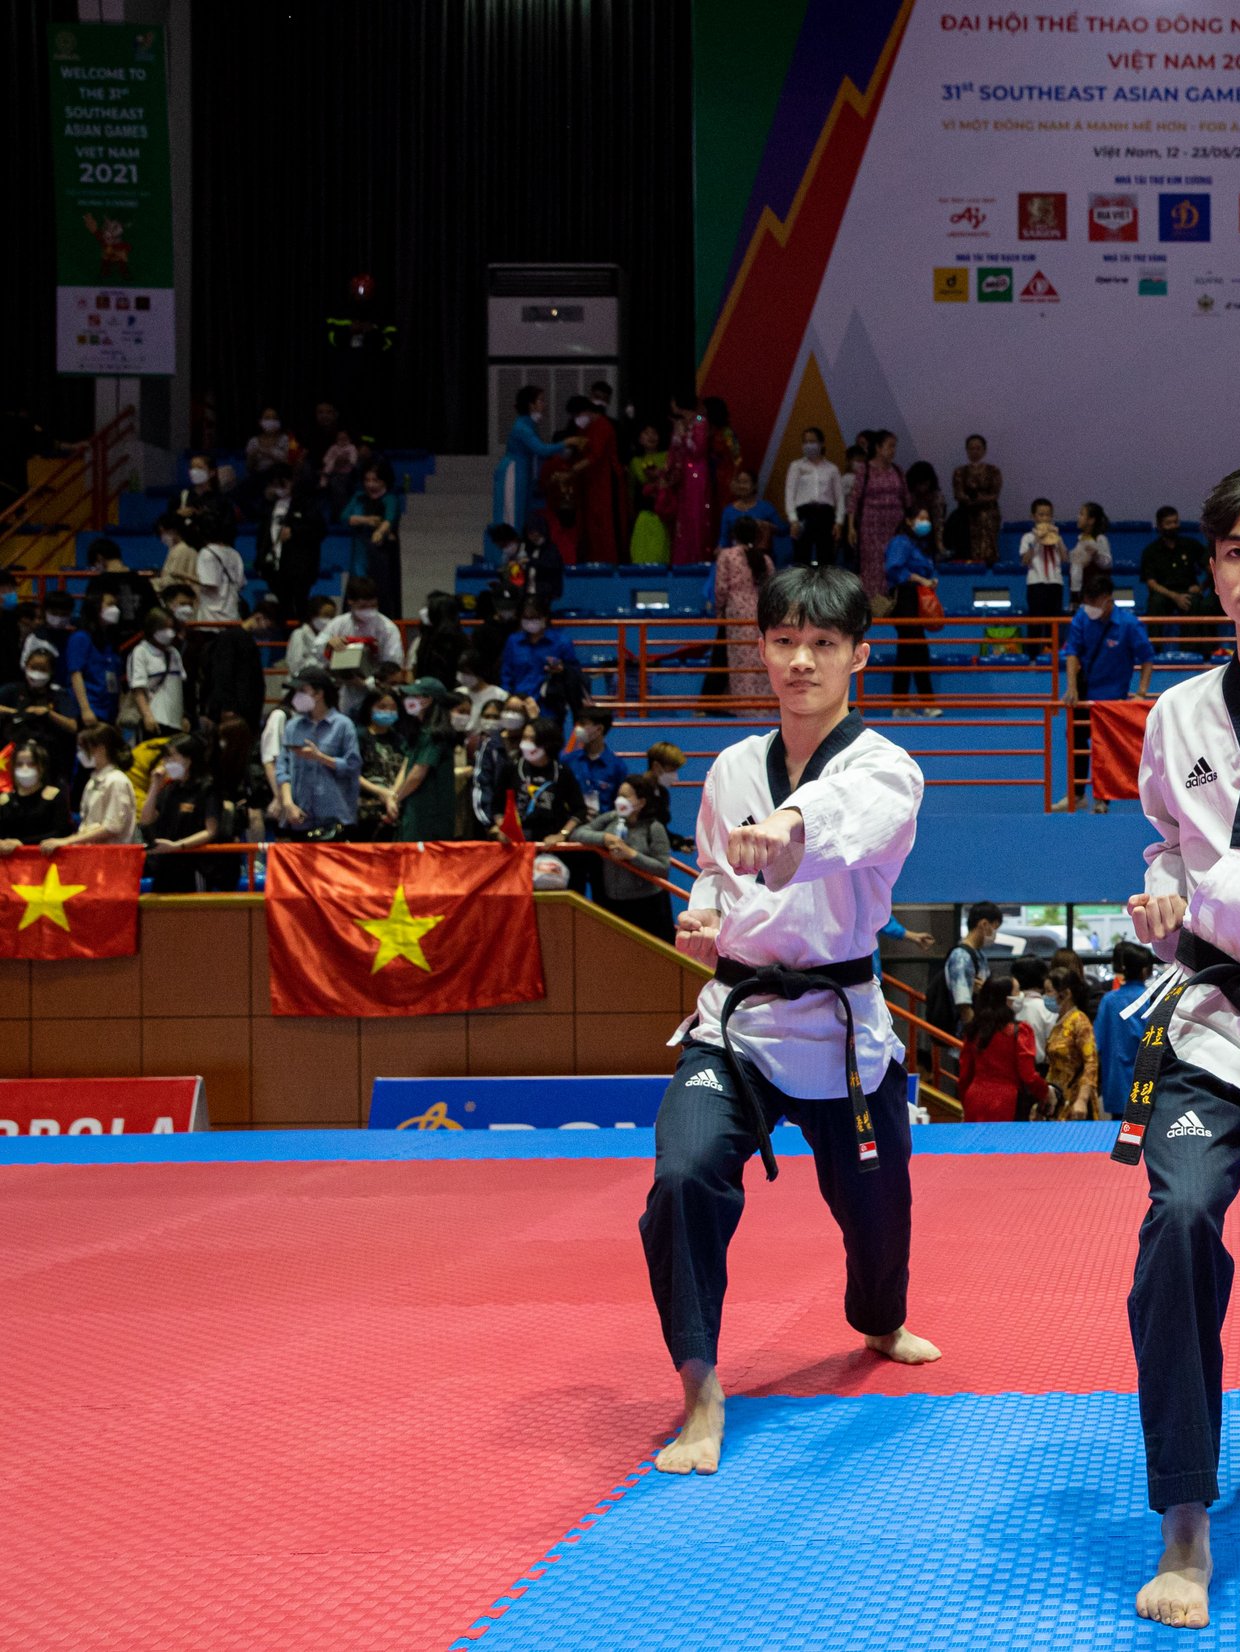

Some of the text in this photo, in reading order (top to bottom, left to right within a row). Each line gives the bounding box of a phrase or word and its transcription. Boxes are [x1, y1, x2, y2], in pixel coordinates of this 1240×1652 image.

[940, 14, 980, 35] ĐẠI
[988, 12, 1028, 36] HỘI
[1036, 11, 1078, 32] THỂ
[1086, 15, 1149, 33] THAO
[1156, 14, 1223, 34] ĐÔNG
[1107, 50, 1156, 73] VIỆT
[1164, 53, 1216, 70] NAM
[60, 65, 147, 81] WELCOME TO
[79, 86, 105, 100] THE
[942, 82, 974, 101] 31st
[979, 84, 1107, 101] SOUTHEAST
[1113, 86, 1178, 102] ASIAN
[64, 105, 144, 120] SOUTHEAST
[64, 123, 149, 139] ASIAN GAMES
[1038, 121, 1070, 132] NAM
[1199, 121, 1226, 132] FOR
[1230, 121, 1240, 132] A
[75, 146, 140, 159] VIET NAM
[1093, 147, 1121, 159] Việt
[1125, 147, 1162, 160] Nam,
[1166, 147, 1180, 159] 12
[79, 162, 138, 184] 2021
[1185, 771, 1218, 789] adidas
[685, 1079, 723, 1091] adidas
[1166, 1126, 1213, 1138] adidas
